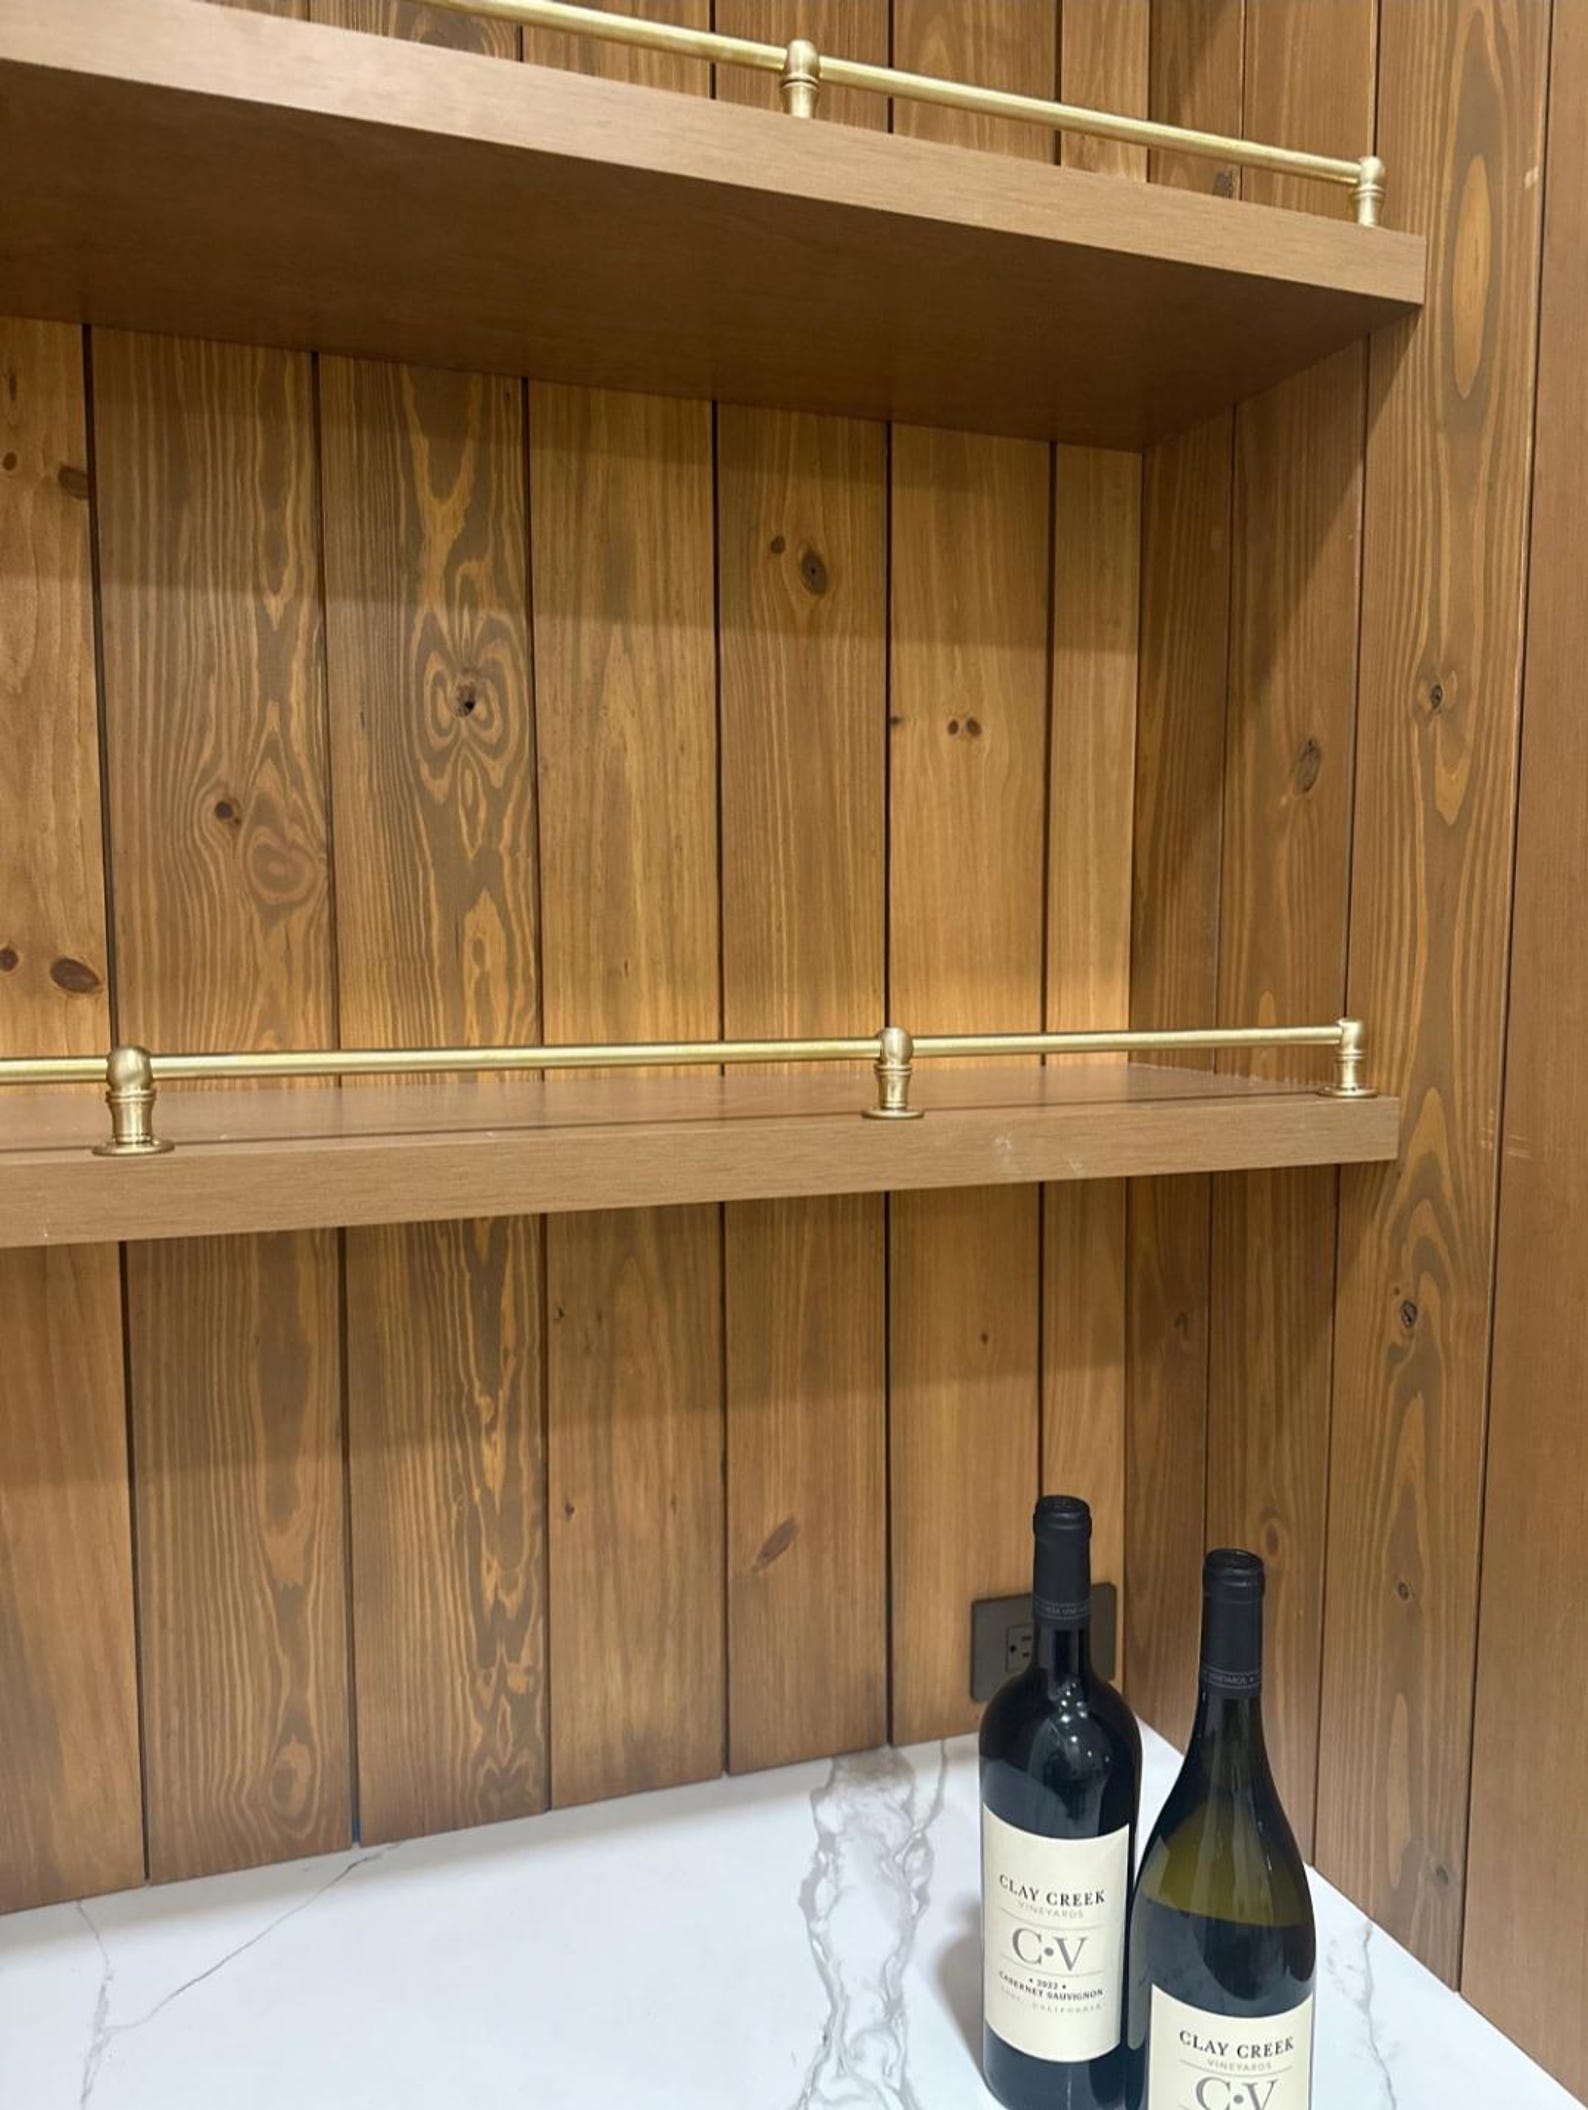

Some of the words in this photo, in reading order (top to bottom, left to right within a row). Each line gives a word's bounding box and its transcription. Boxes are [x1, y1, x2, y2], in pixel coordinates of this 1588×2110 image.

[999, 1874, 1039, 1902] CLAY
[1046, 1889, 1105, 1907] CREEK
[1017, 1902, 1084, 1918] VINEYARDS
[999, 1970, 1043, 1997] CABERNET
[1047, 1987, 1103, 2001] SAUVIGNON
[1179, 2030, 1229, 2056] CLAY
[1237, 2036, 1294, 2059] CREEK
[1208, 2059, 1272, 2072] VINEYARDS
